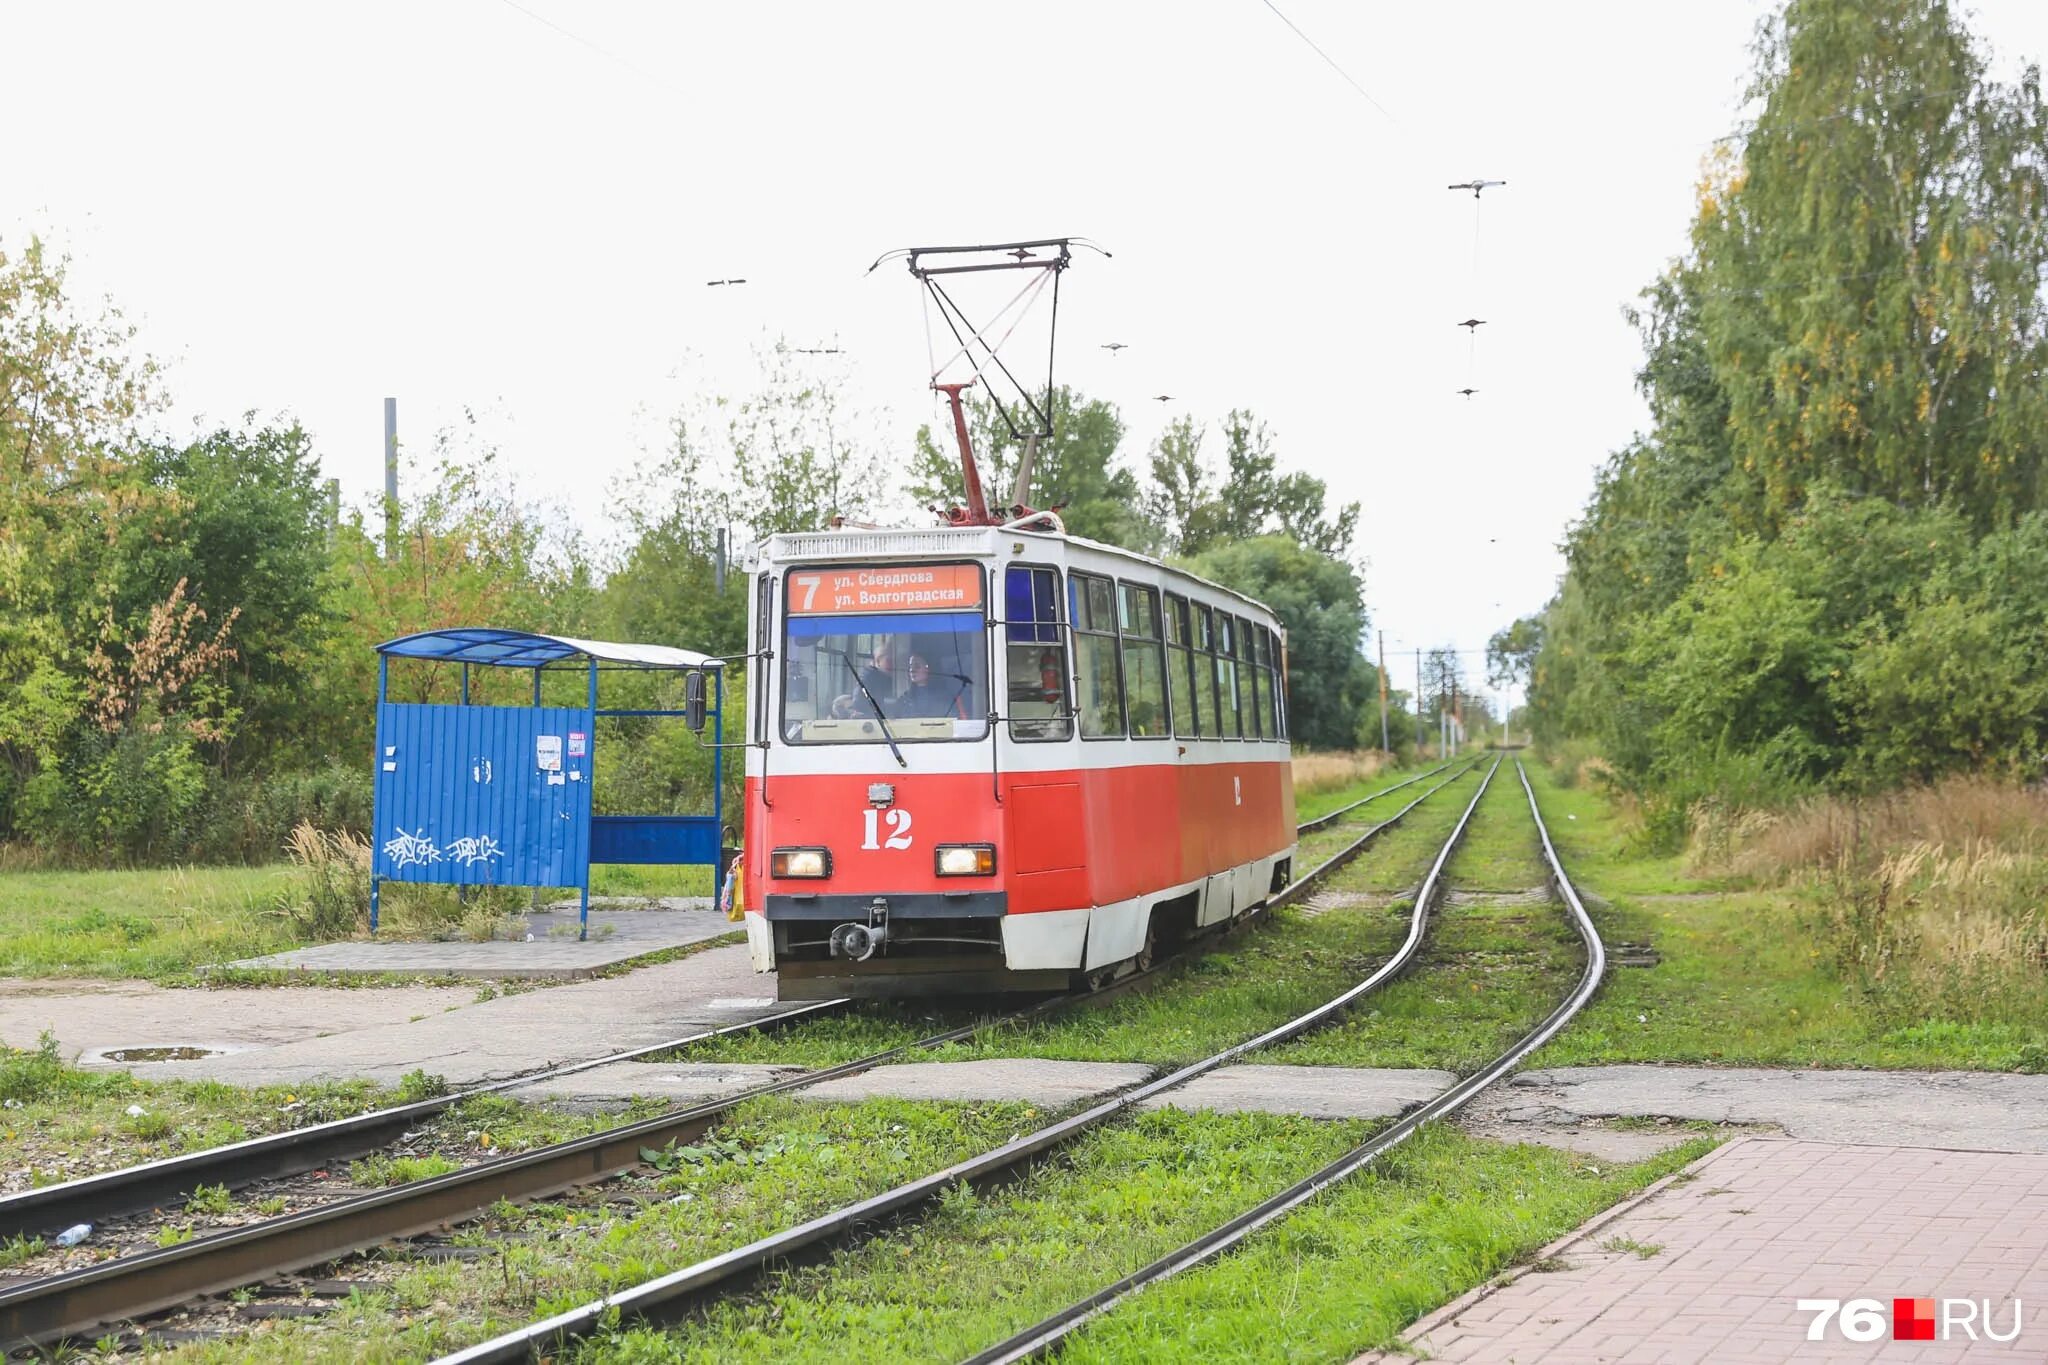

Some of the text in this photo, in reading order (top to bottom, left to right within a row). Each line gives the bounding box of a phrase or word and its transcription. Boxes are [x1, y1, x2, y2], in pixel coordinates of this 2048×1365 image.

[797, 576, 821, 610] 7
[834, 572, 934, 591] ул. Свердлова
[835, 588, 964, 609] ул. Волгоградская
[861, 808, 912, 850] 12
